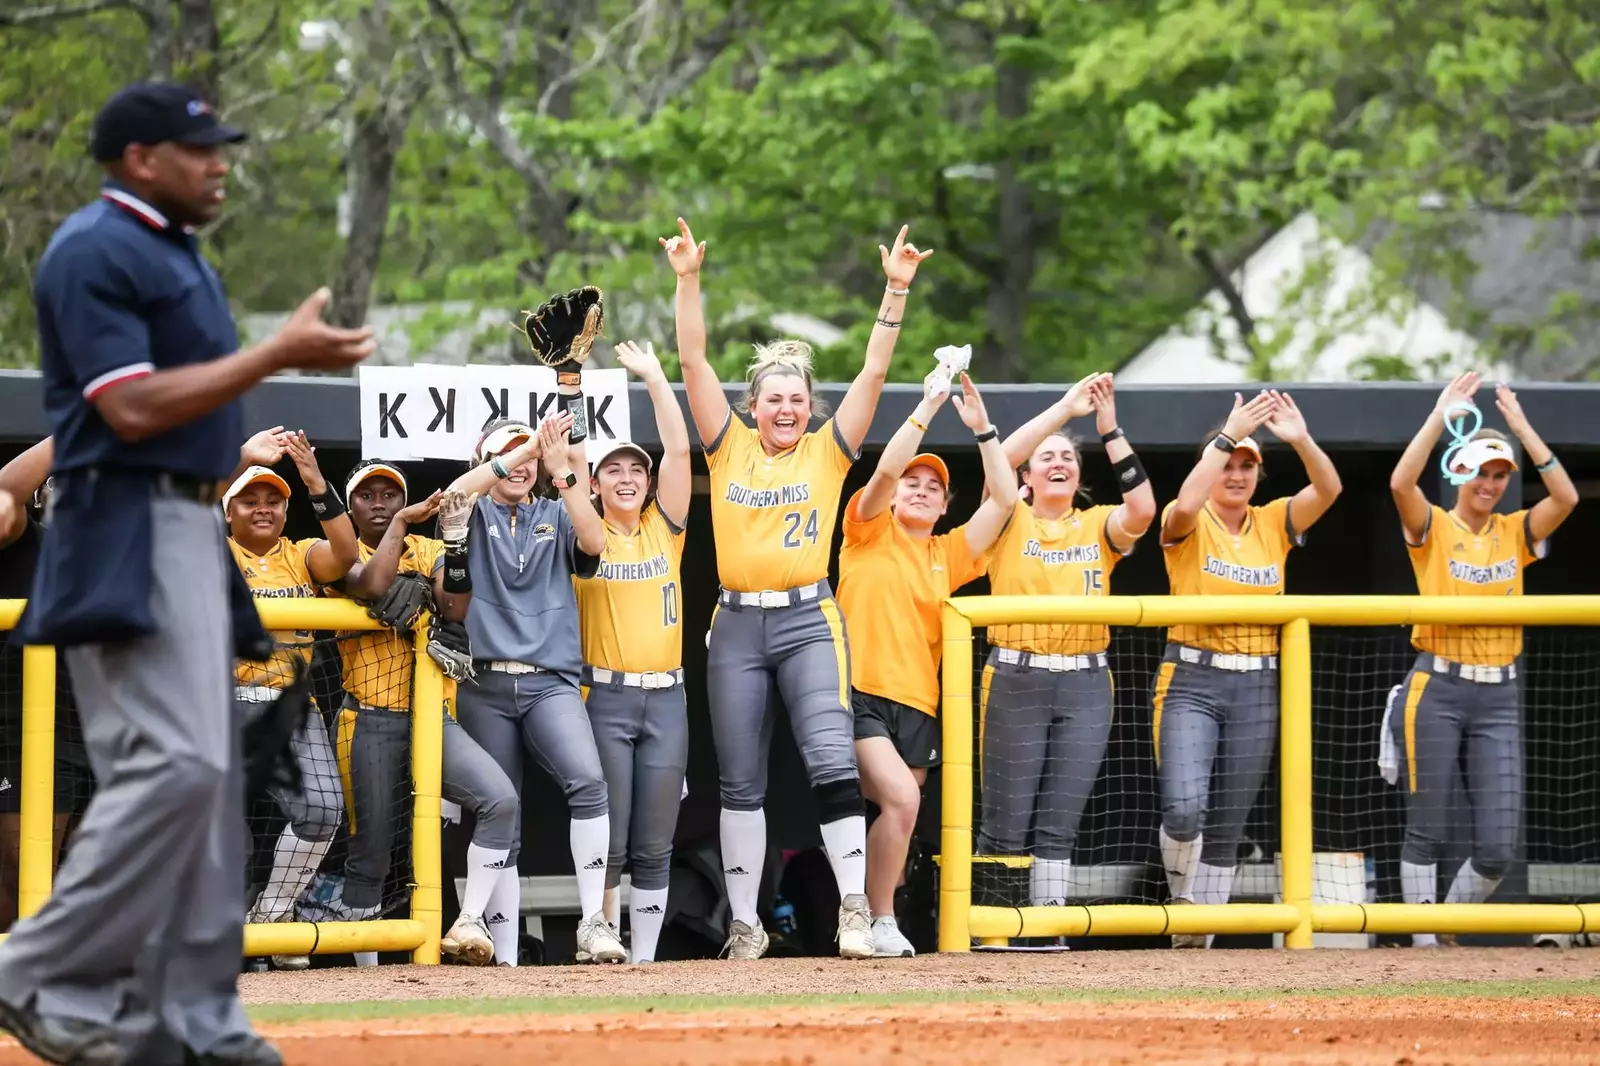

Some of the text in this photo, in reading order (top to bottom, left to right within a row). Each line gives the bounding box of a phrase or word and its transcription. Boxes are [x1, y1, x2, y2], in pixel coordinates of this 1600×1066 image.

[378, 392, 409, 439] K
[528, 391, 557, 431] K
[586, 394, 616, 440] K
[725, 483, 809, 507] SOUTHERN MISS
[783, 509, 819, 548] 24
[1073, 544, 1099, 561] MISS
[1203, 555, 1260, 584] SOUTHERN
[662, 582, 678, 627] 10
